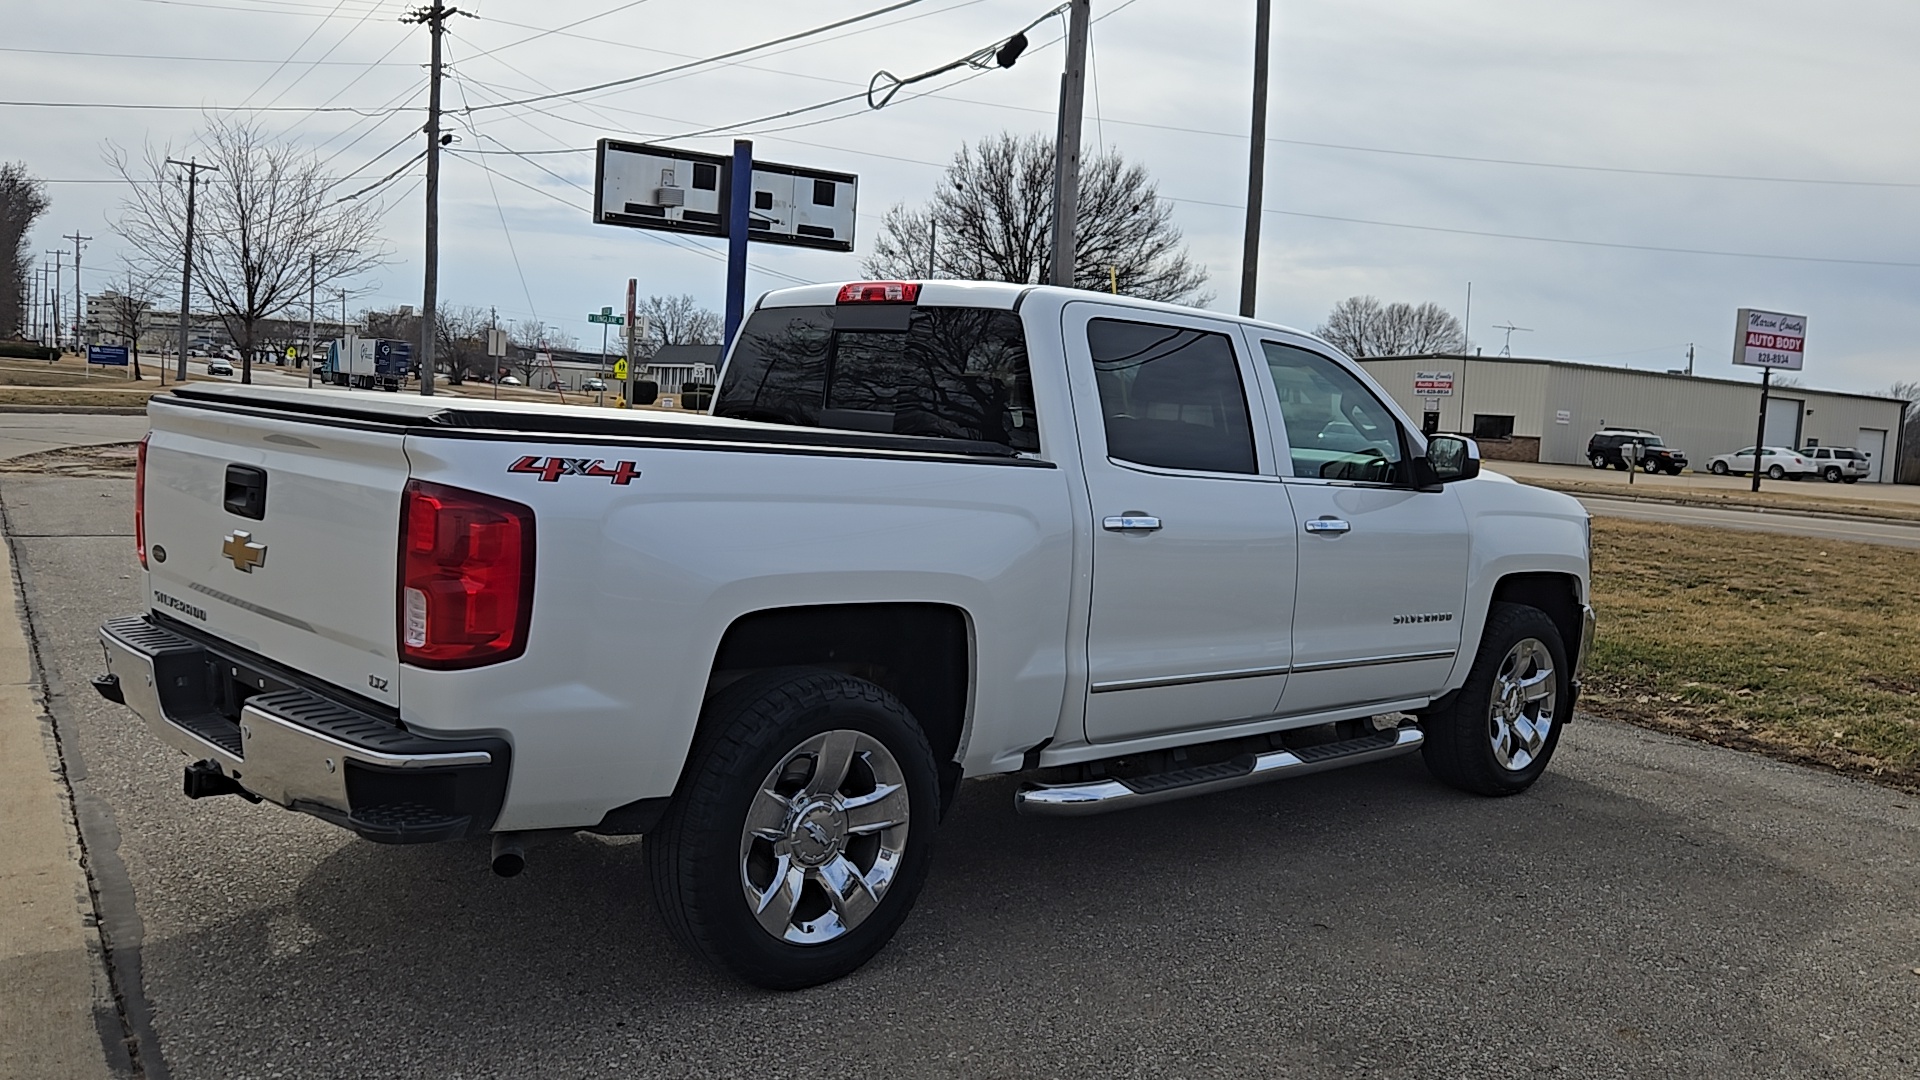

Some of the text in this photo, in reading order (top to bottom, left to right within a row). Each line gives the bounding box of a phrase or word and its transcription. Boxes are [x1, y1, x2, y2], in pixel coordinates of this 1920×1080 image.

[1747, 333, 1802, 350] AUTO BODY
[368, 674, 389, 692] LTZ
